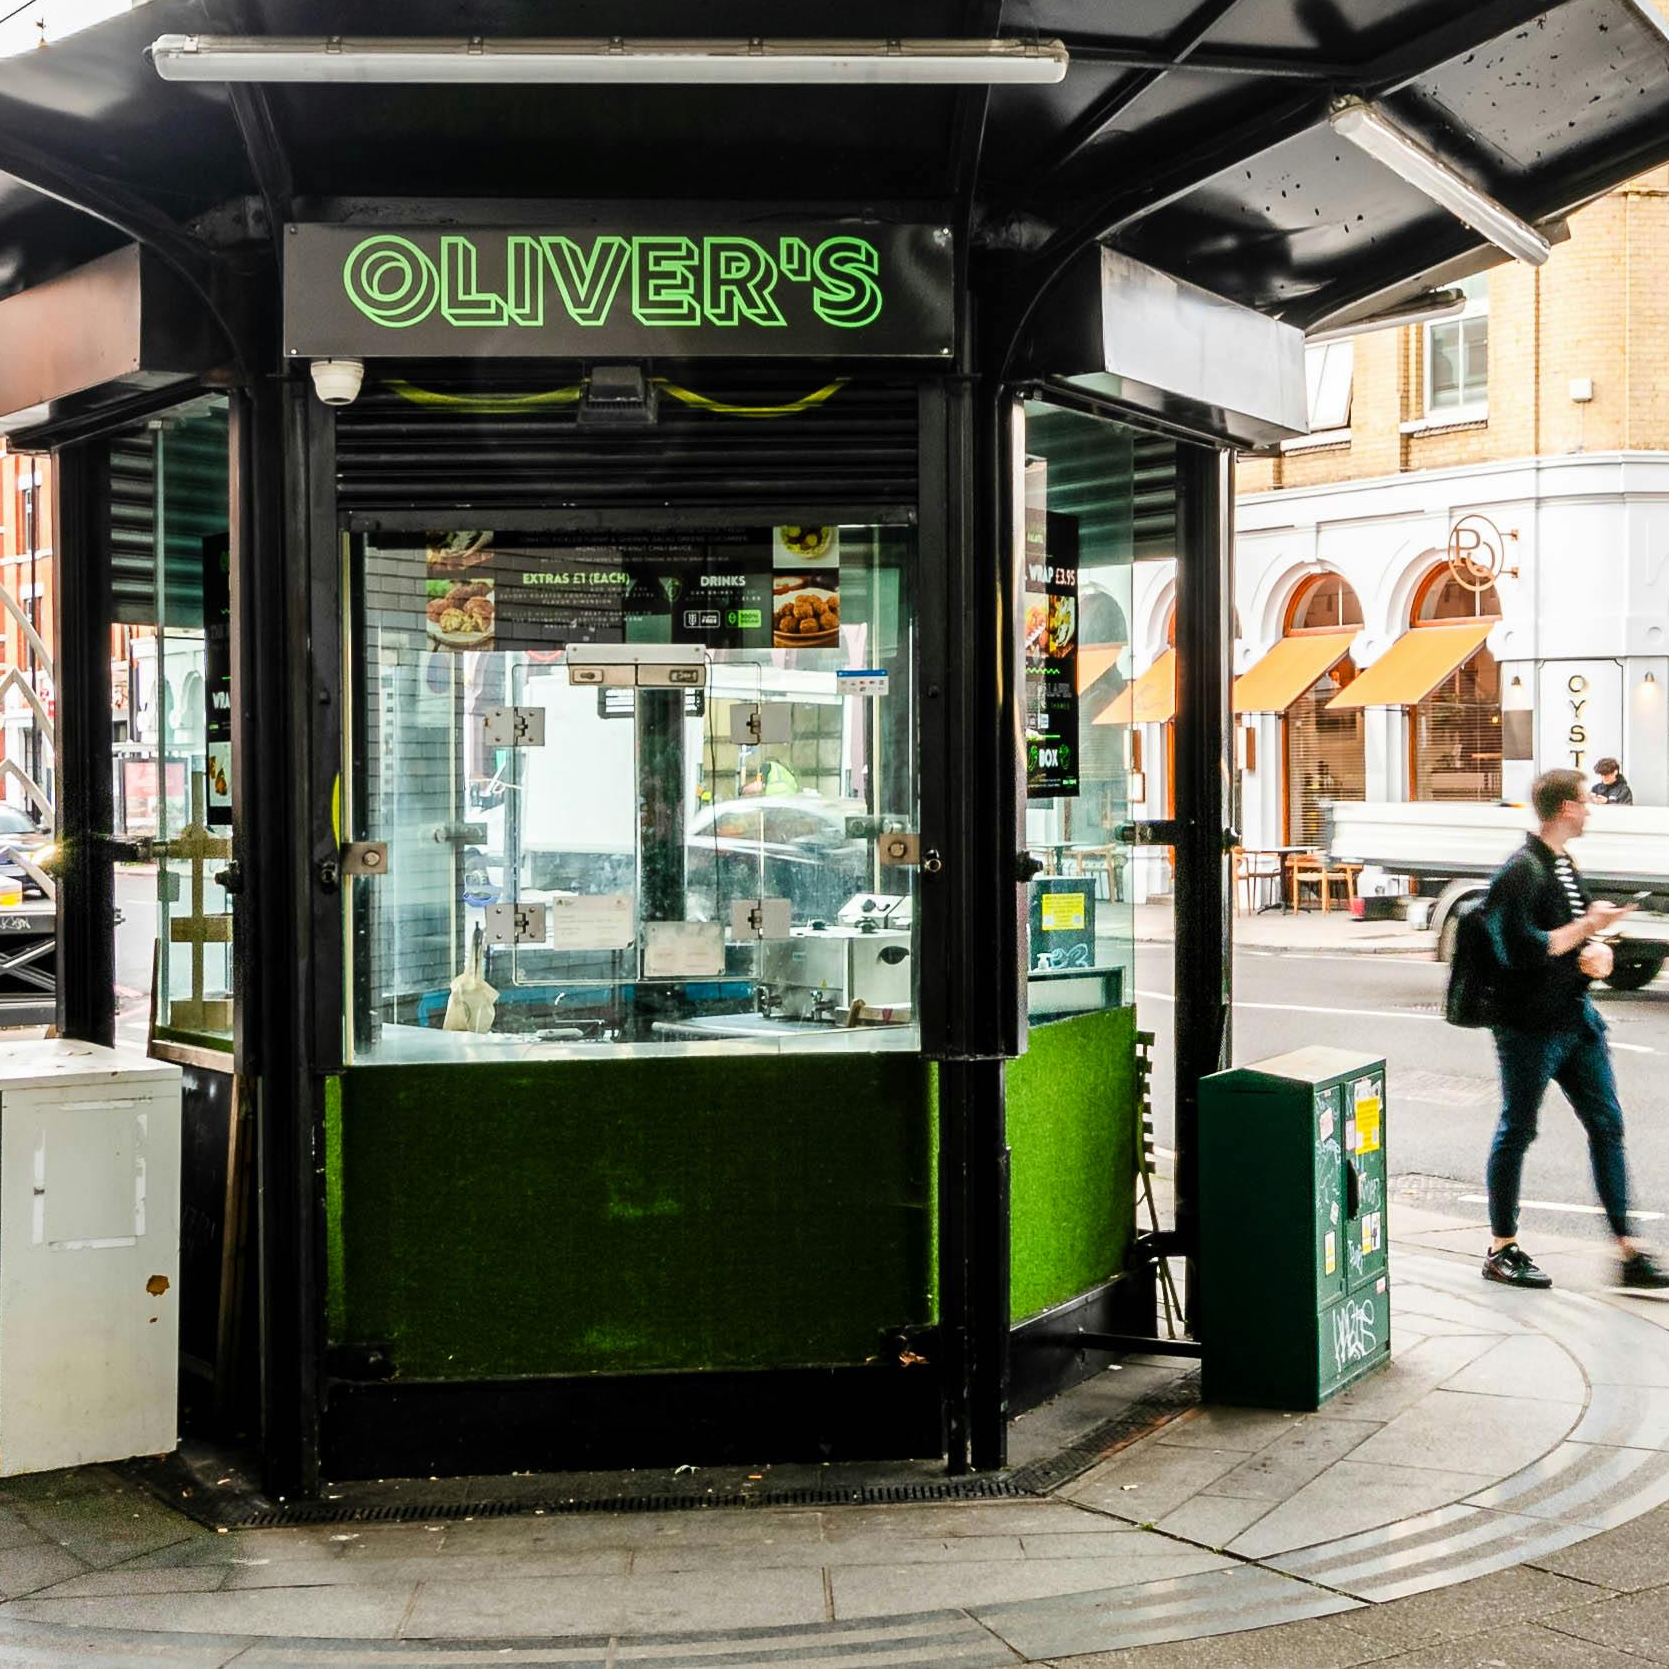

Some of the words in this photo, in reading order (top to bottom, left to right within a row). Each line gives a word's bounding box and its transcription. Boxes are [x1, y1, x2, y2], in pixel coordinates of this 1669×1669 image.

[343, 233, 883, 329] OLIVER'S
[522, 573, 570, 584] EXTRAS
[572, 573, 586, 584] £1
[589, 572, 630, 585] (EACH)
[700, 575, 746, 587] DRINKS
[1029, 564, 1053, 584] WRAP
[1055, 568, 1076, 587] £3.95
[1038, 748, 1059, 768] BOX
